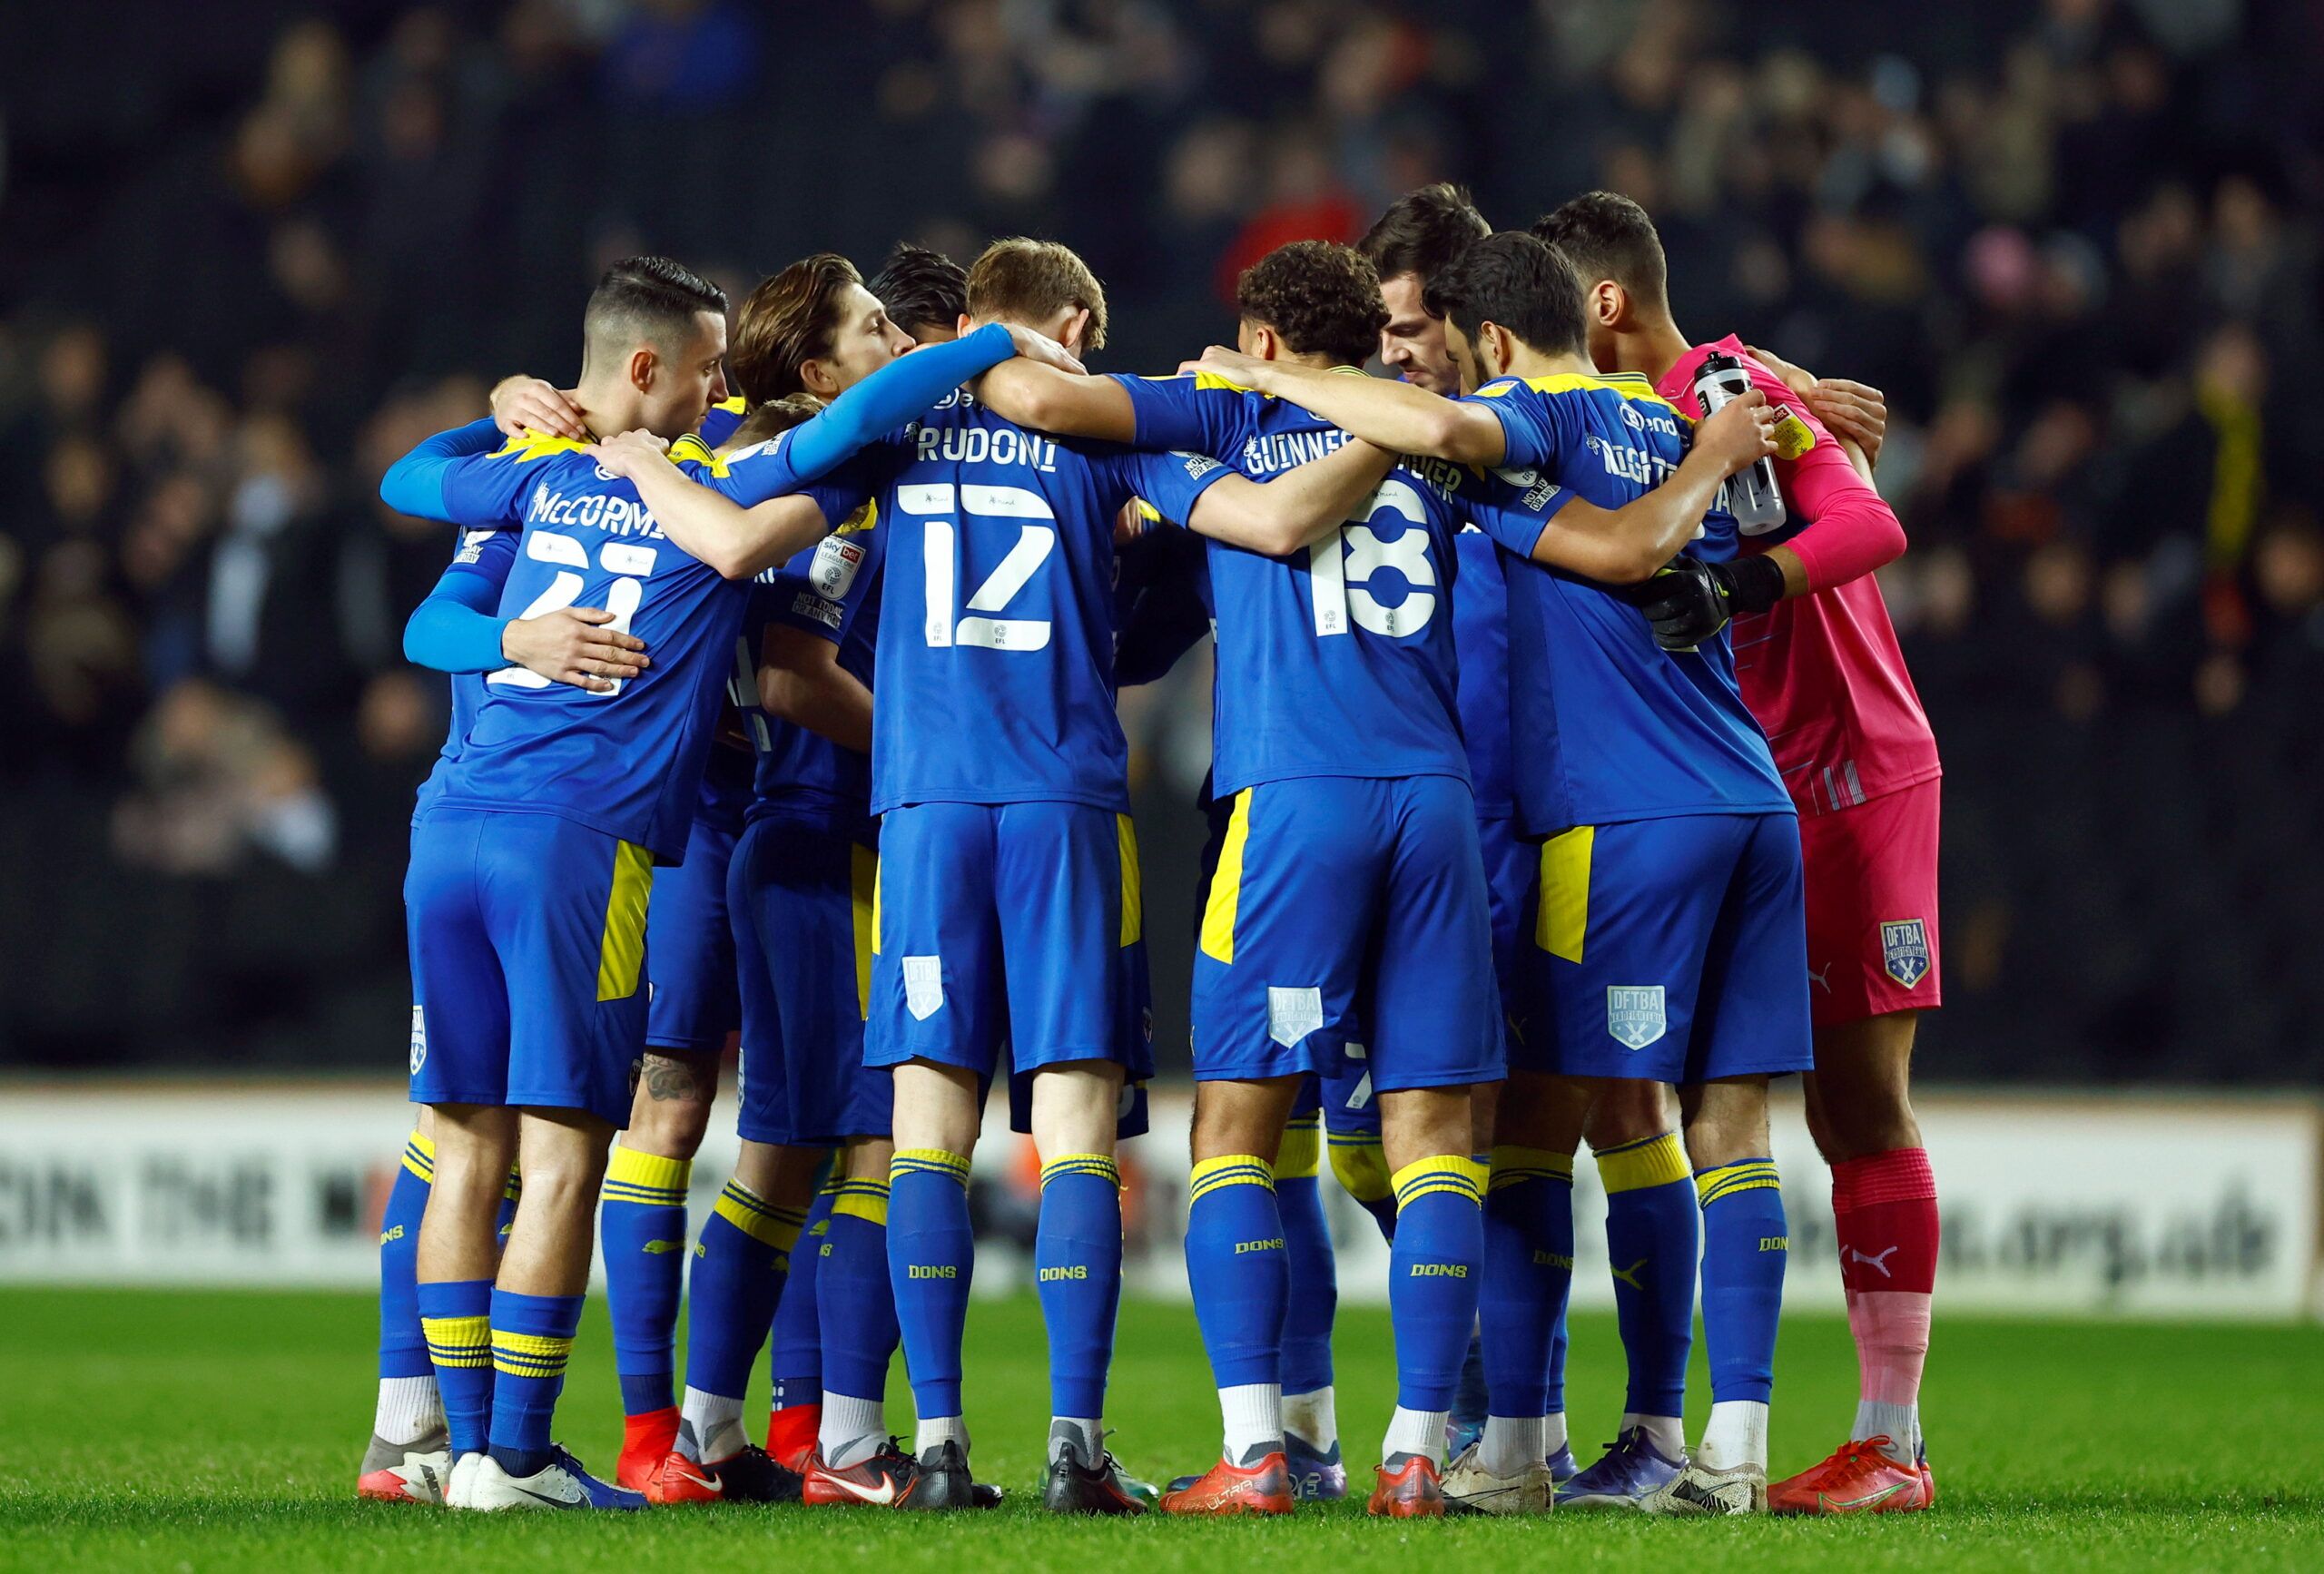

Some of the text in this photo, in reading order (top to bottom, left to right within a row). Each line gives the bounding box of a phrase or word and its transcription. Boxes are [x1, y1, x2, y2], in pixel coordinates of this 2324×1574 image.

[917, 427, 1060, 473] RUDONI
[1521, 488, 1539, 506] NOT
[1531, 498, 1544, 510] OR
[823, 541, 841, 553] sky
[822, 551, 844, 565] LEAGUE
[1310, 480, 1436, 637] 18
[898, 483, 1055, 652] 12
[822, 583, 834, 595] EFL
[1886, 924, 1921, 947] DFTBA
[1613, 990, 1659, 1010] DFTBA
[1235, 1238, 1284, 1254] DONS
[1758, 1236, 1788, 1252] DON
[1533, 1249, 1574, 1270] DONS
[909, 1264, 957, 1279] DONS
[1039, 1264, 1088, 1282] DONS
[1410, 1264, 1468, 1278] DONS
[1206, 1480, 1253, 1510] ULTRA
